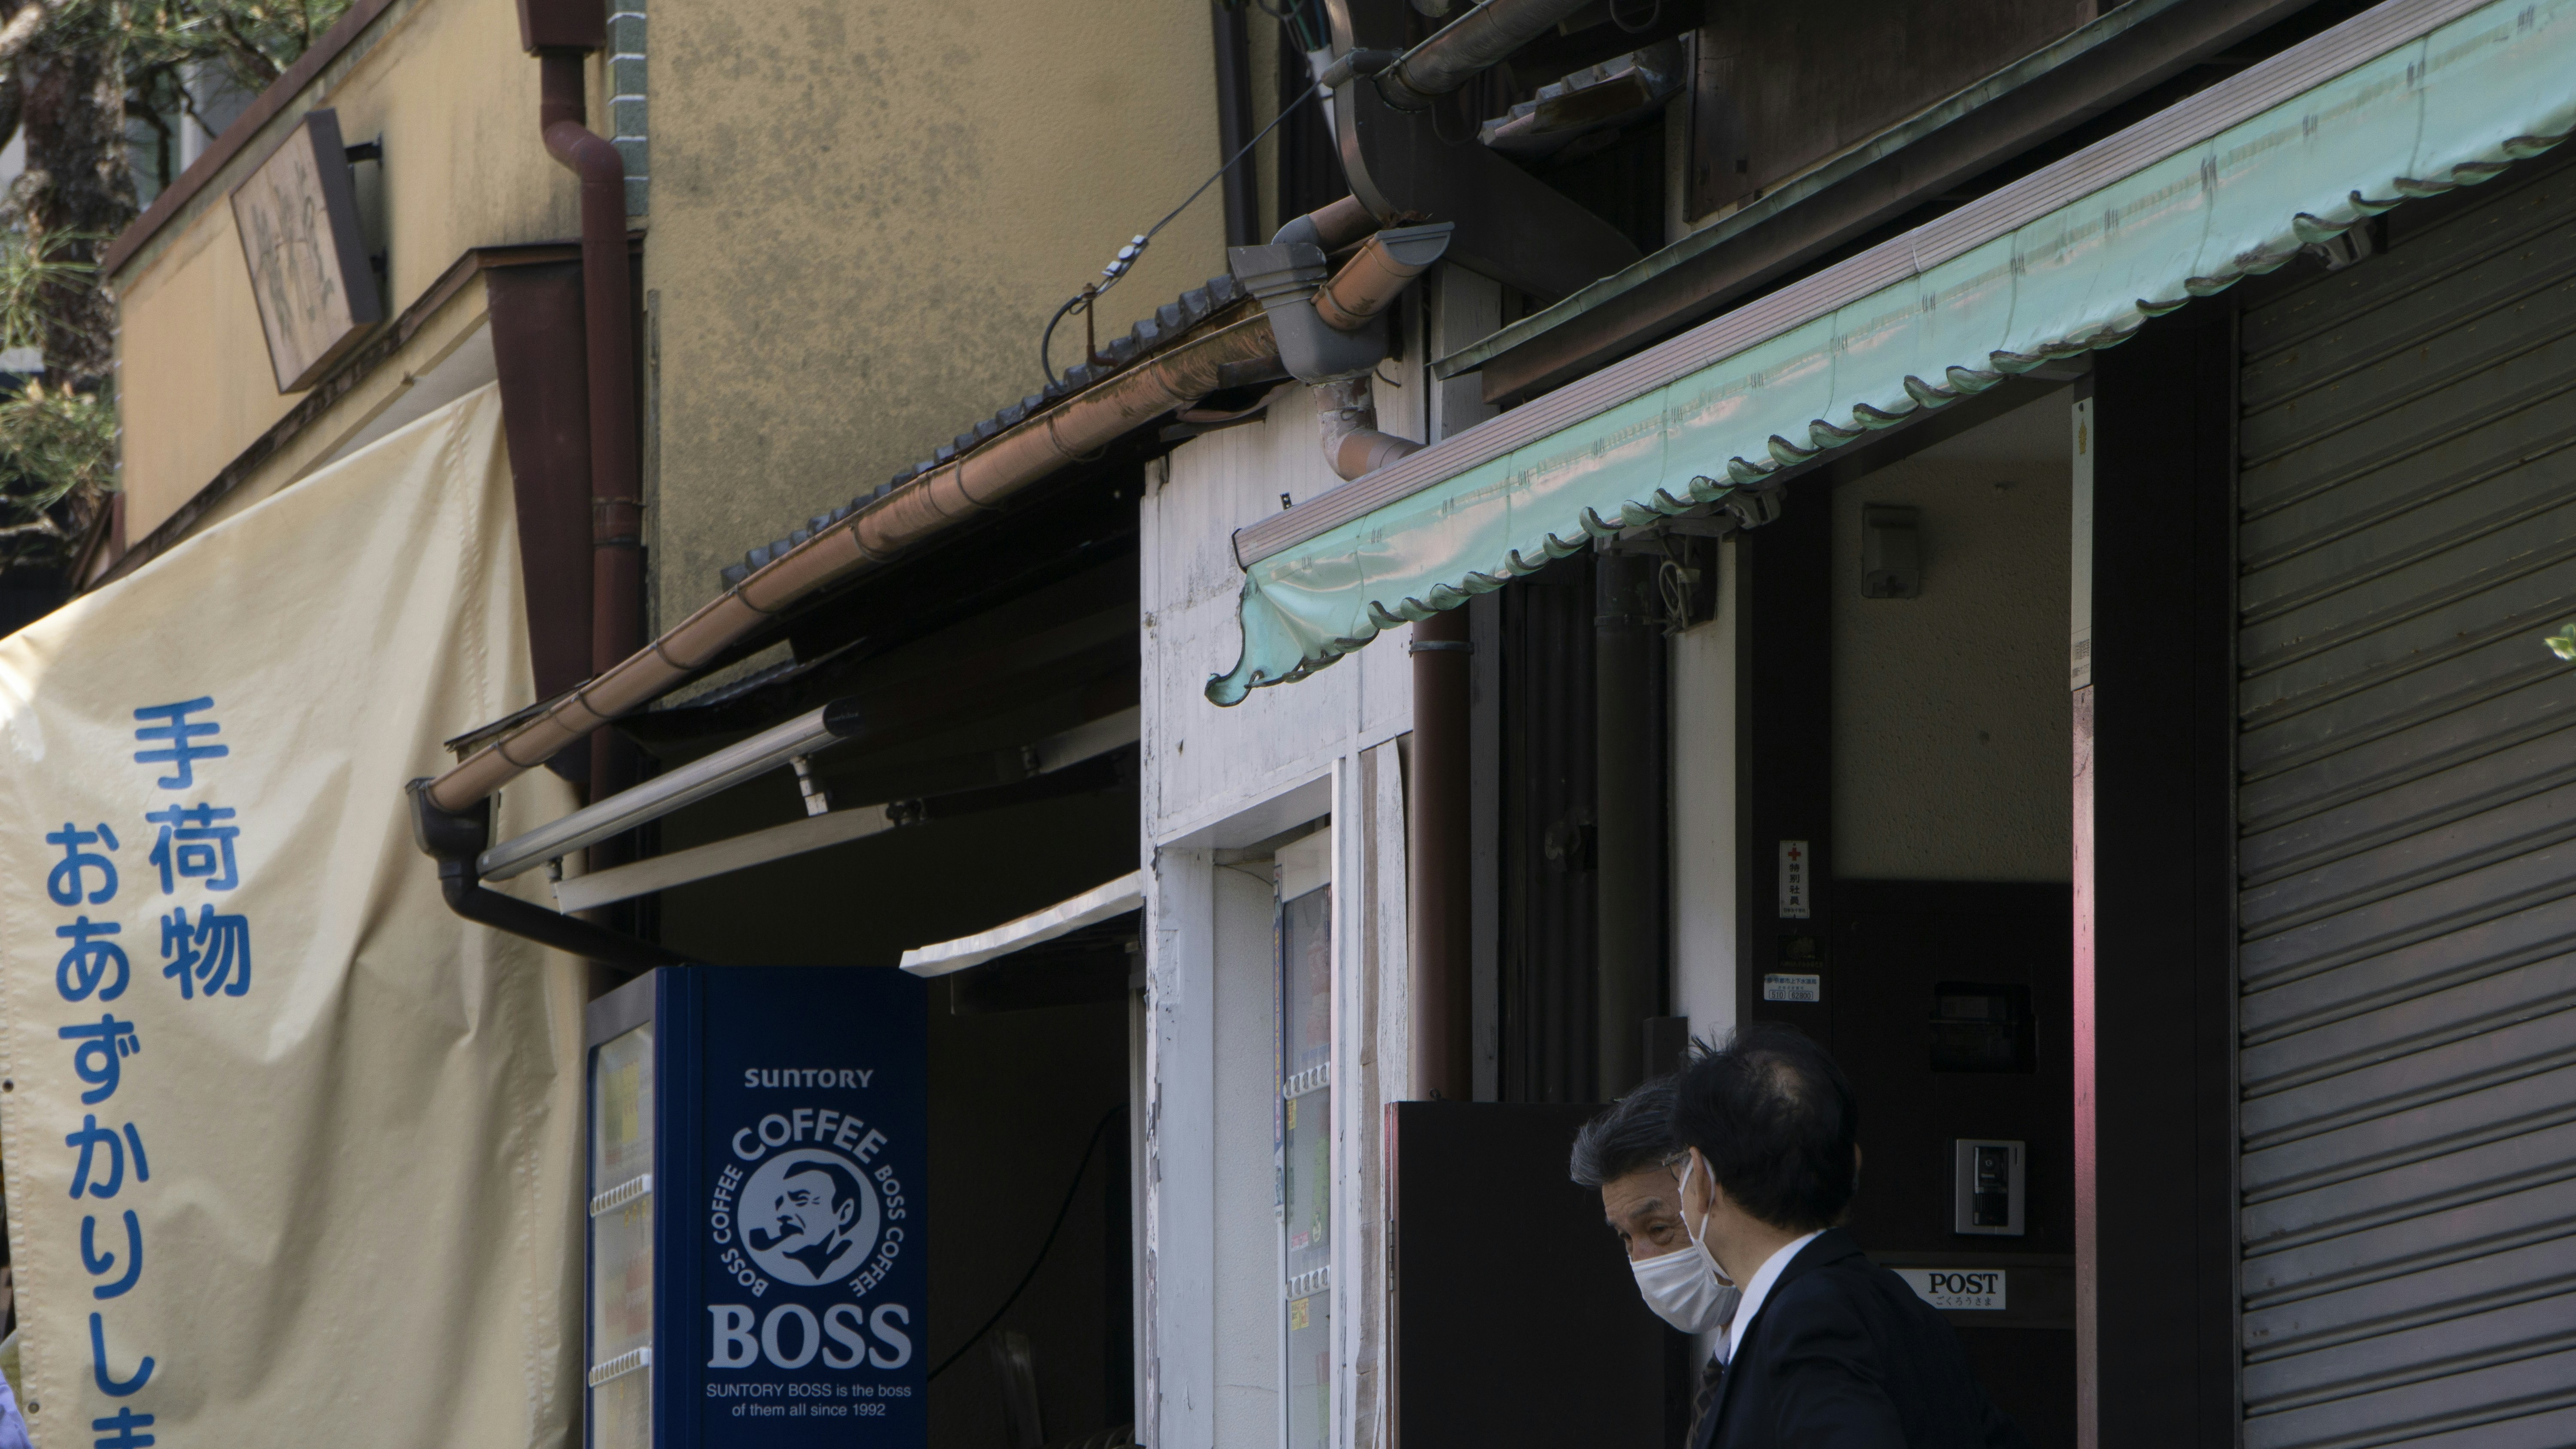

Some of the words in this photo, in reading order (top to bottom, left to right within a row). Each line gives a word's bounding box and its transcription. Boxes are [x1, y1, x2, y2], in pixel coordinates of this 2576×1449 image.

[134, 696, 251, 999] 手荷物
[1789, 863, 1801, 906] 特別社員
[732, 1108, 888, 1164] COFFEE
[711, 1164, 743, 1244] COFFEE
[874, 1164, 906, 1220] BOSS
[720, 1248, 769, 1297] BOSS
[849, 1227, 904, 1297] COFFEE
[1929, 1273, 1998, 1294] POST
[1936, 1296, 1992, 1306] ごくろうさま
[707, 1303, 912, 1370] BOSS
[706, 1383, 784, 1397] SUNTORY
[788, 1383, 832, 1397] BOSS
[836, 1384, 848, 1397] is
[852, 1384, 874, 1397] the
[878, 1384, 911, 1397] boss
[732, 1403, 746, 1416] of
[750, 1404, 785, 1416] them
[789, 1403, 806, 1416] all
[811, 1403, 847, 1416] since
[853, 1403, 886, 1416] 1992
